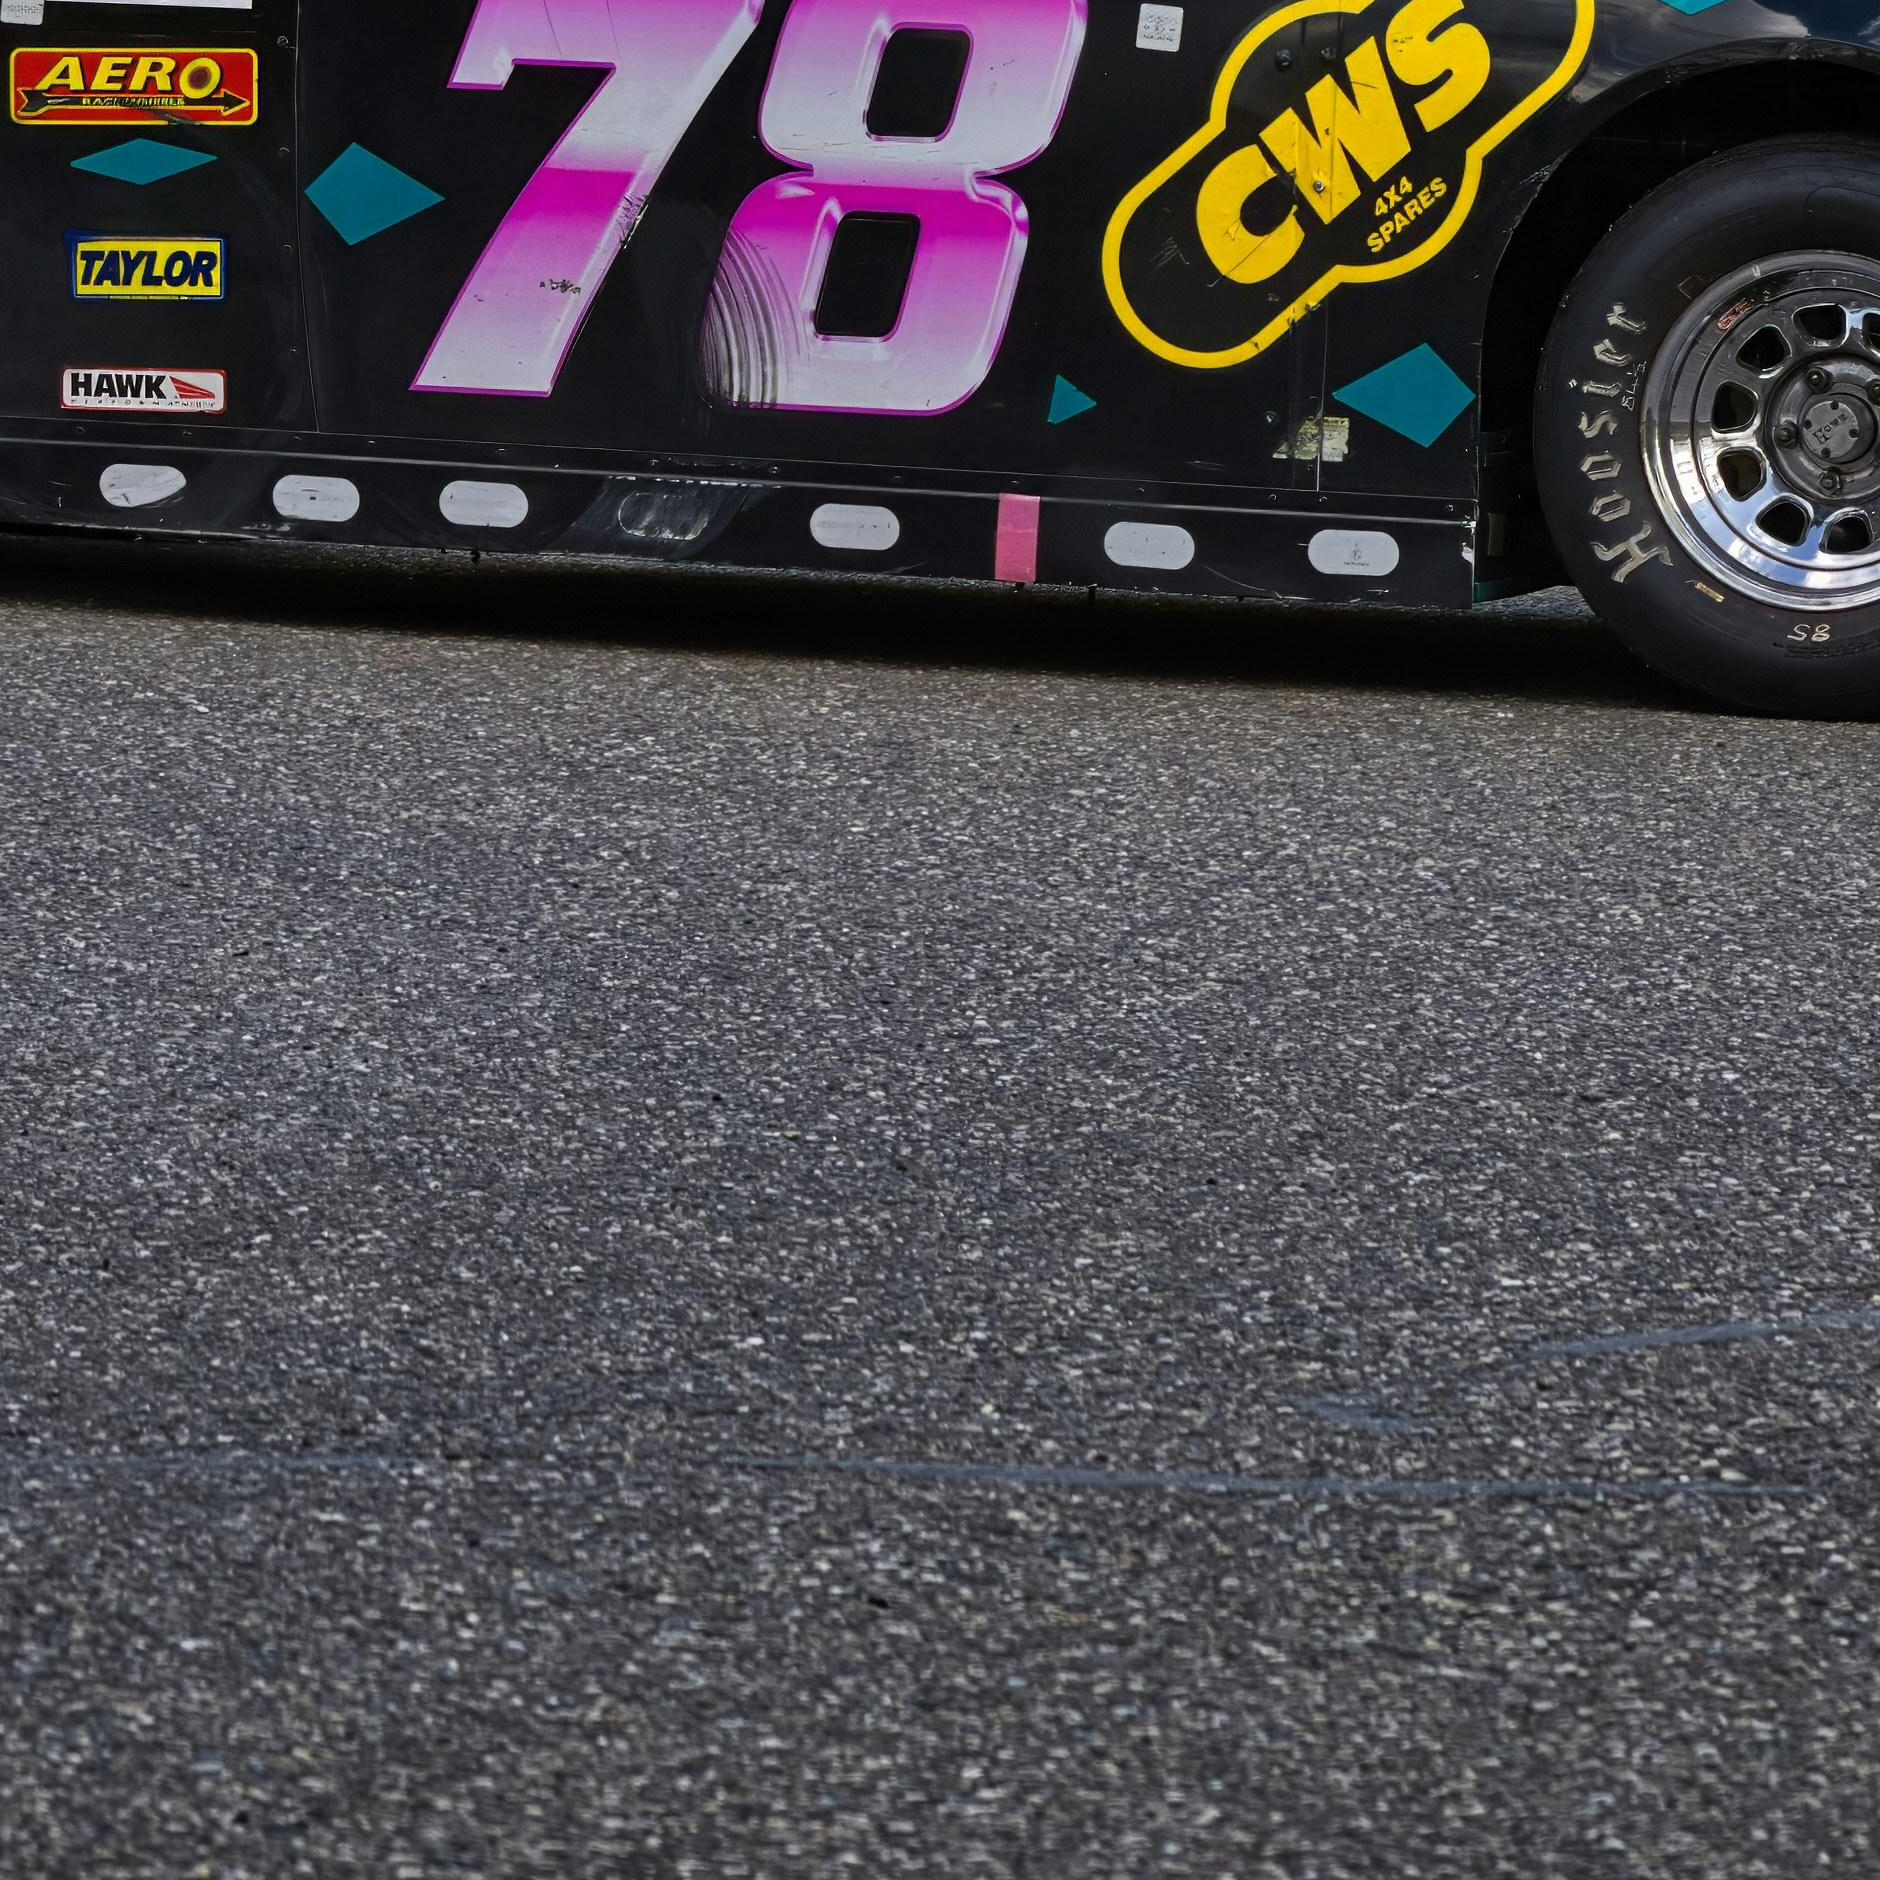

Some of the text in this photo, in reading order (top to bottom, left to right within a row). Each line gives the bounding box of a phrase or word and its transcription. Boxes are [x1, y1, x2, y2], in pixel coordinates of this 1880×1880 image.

[34, 55, 222, 100] AERO
[1367, 176, 1448, 253] SPARES
[1374, 175, 1416, 217] 4X4
[79, 249, 219, 288] TAYLOR
[70, 372, 167, 400] HAWK
